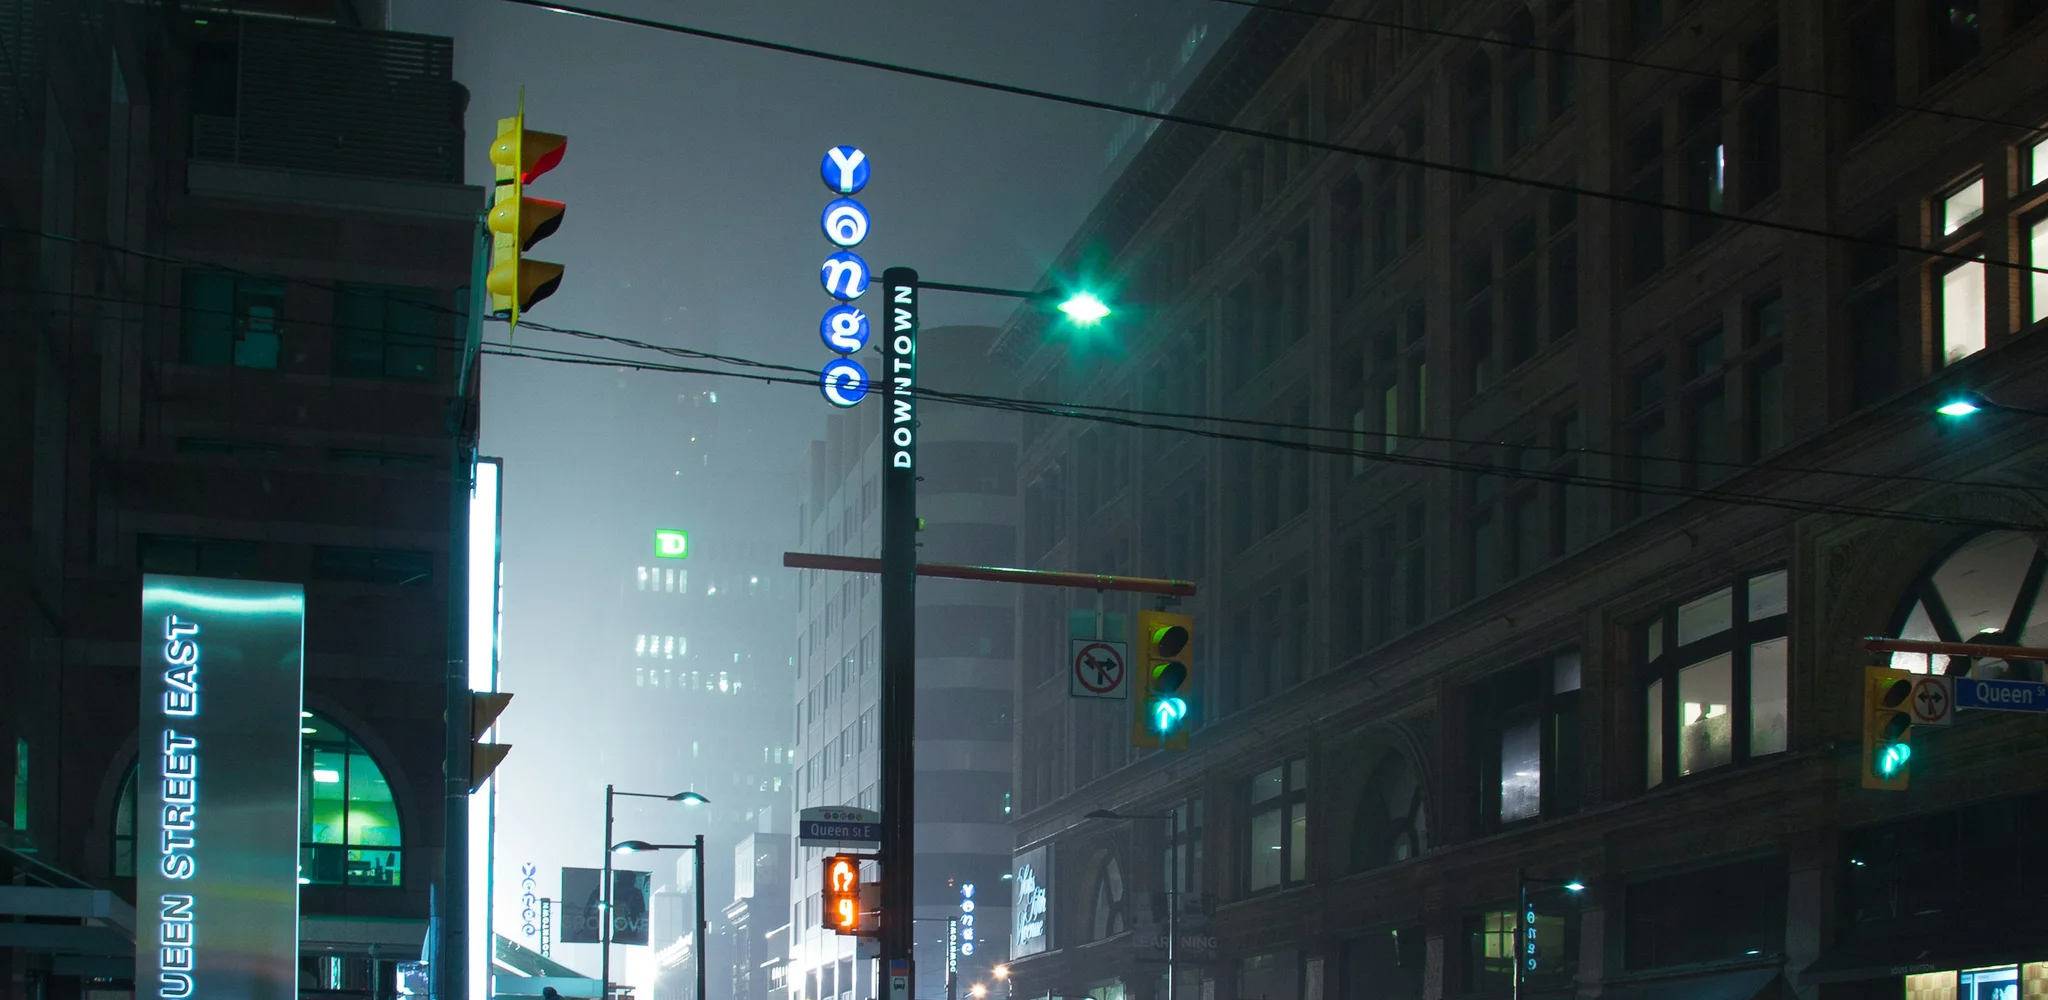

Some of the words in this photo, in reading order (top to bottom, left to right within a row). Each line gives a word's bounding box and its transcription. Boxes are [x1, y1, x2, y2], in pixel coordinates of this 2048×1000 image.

[821, 145, 869, 406] Yonge
[893, 285, 912, 468] DOWNTOWN
[657, 532, 686, 555] TD
[165, 614, 201, 716] EAST
[1975, 682, 2032, 704] Queen
[2036, 686, 2047, 697] St
[162, 729, 198, 878] STREET
[810, 822, 849, 837] Queen
[852, 828, 862, 837] St
[864, 825, 870, 838] E
[541, 902, 550, 957] DOWNTOWN
[839, 898, 853, 927] 9
[960, 882, 975, 956] Yonge
[949, 919, 957, 973] DOWNTOWN
